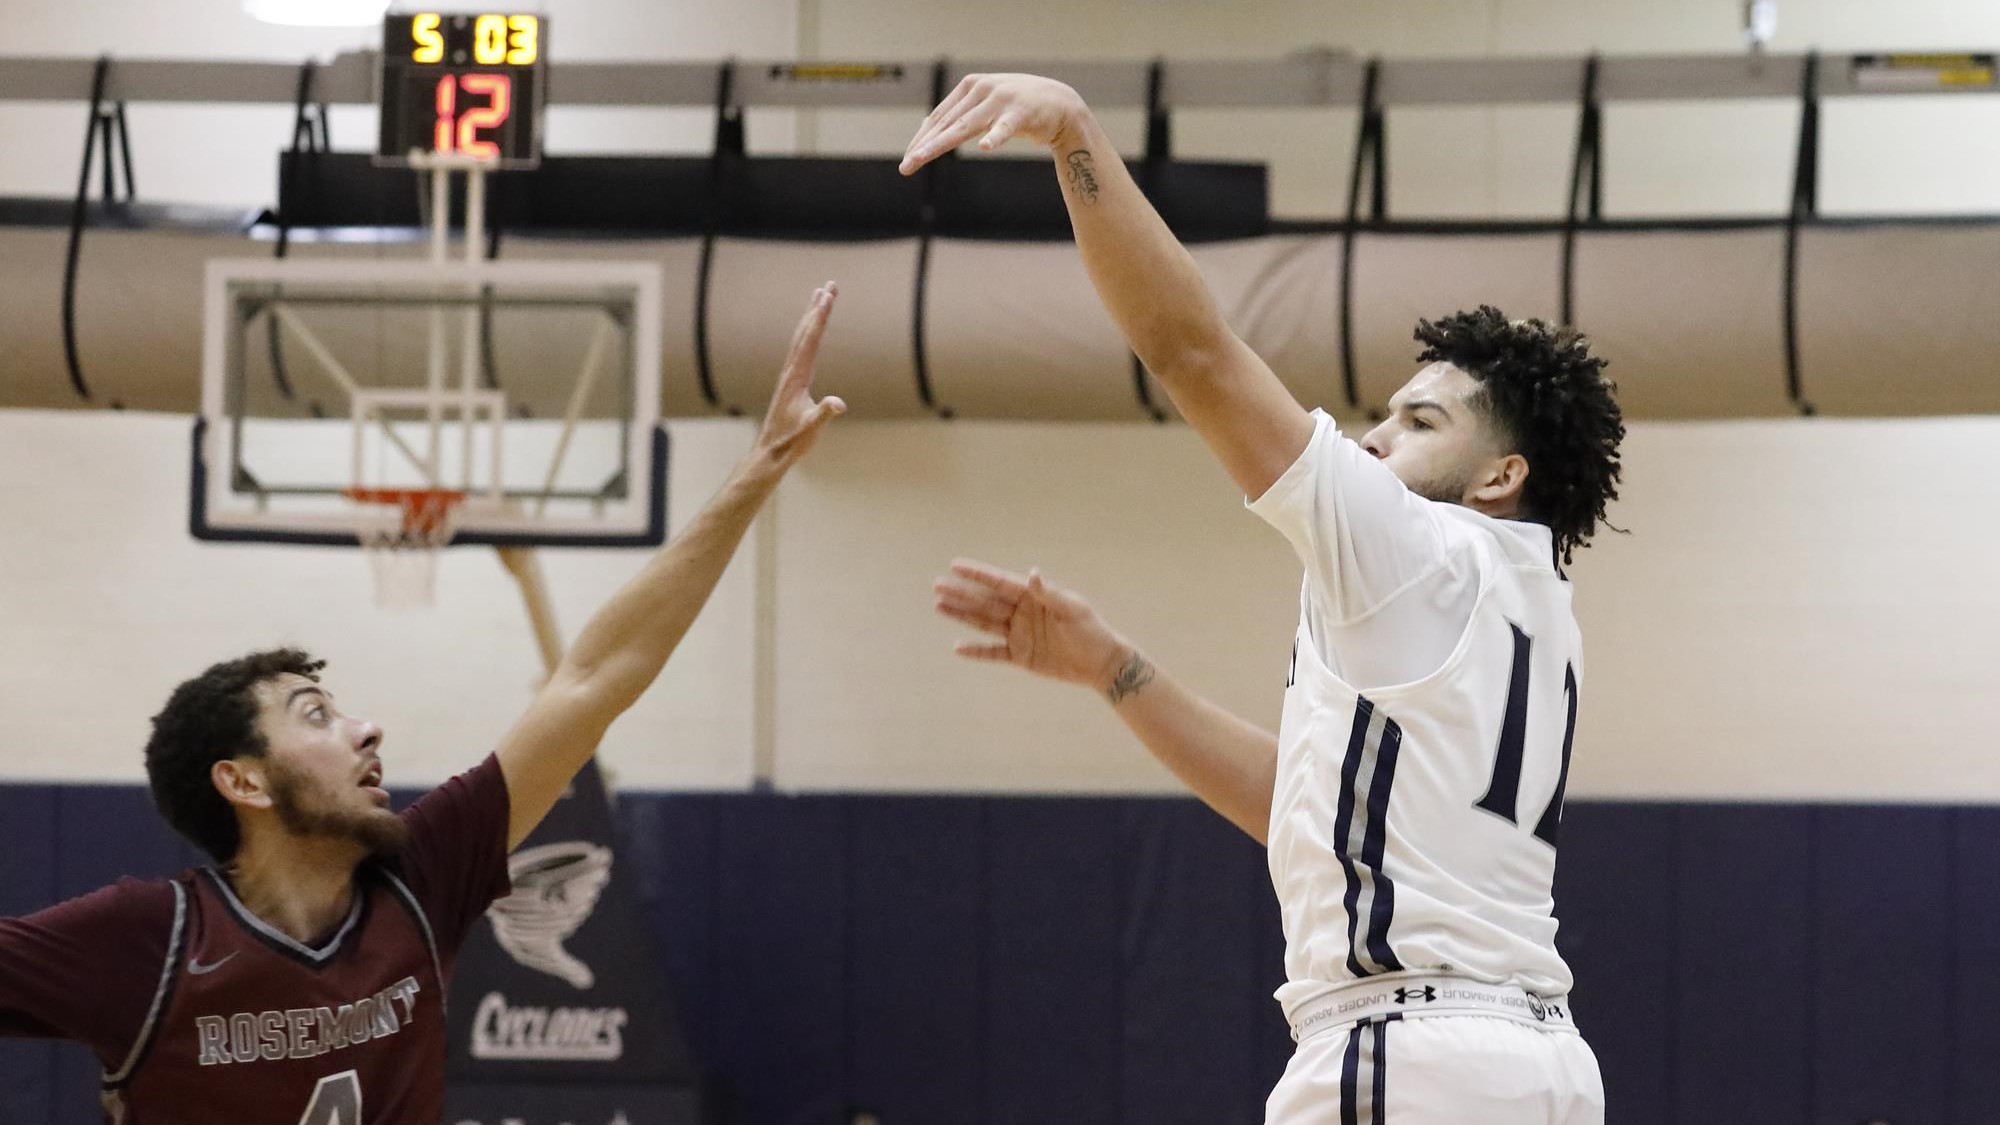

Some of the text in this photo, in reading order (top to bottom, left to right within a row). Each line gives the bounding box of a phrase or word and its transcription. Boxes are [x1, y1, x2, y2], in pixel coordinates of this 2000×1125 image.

[434, 73, 511, 160] 12
[195, 976, 420, 1065] ROSEMONT
[1338, 993, 1388, 1014] UNDER
[1442, 988, 1531, 1008] NDER ARMOUR
